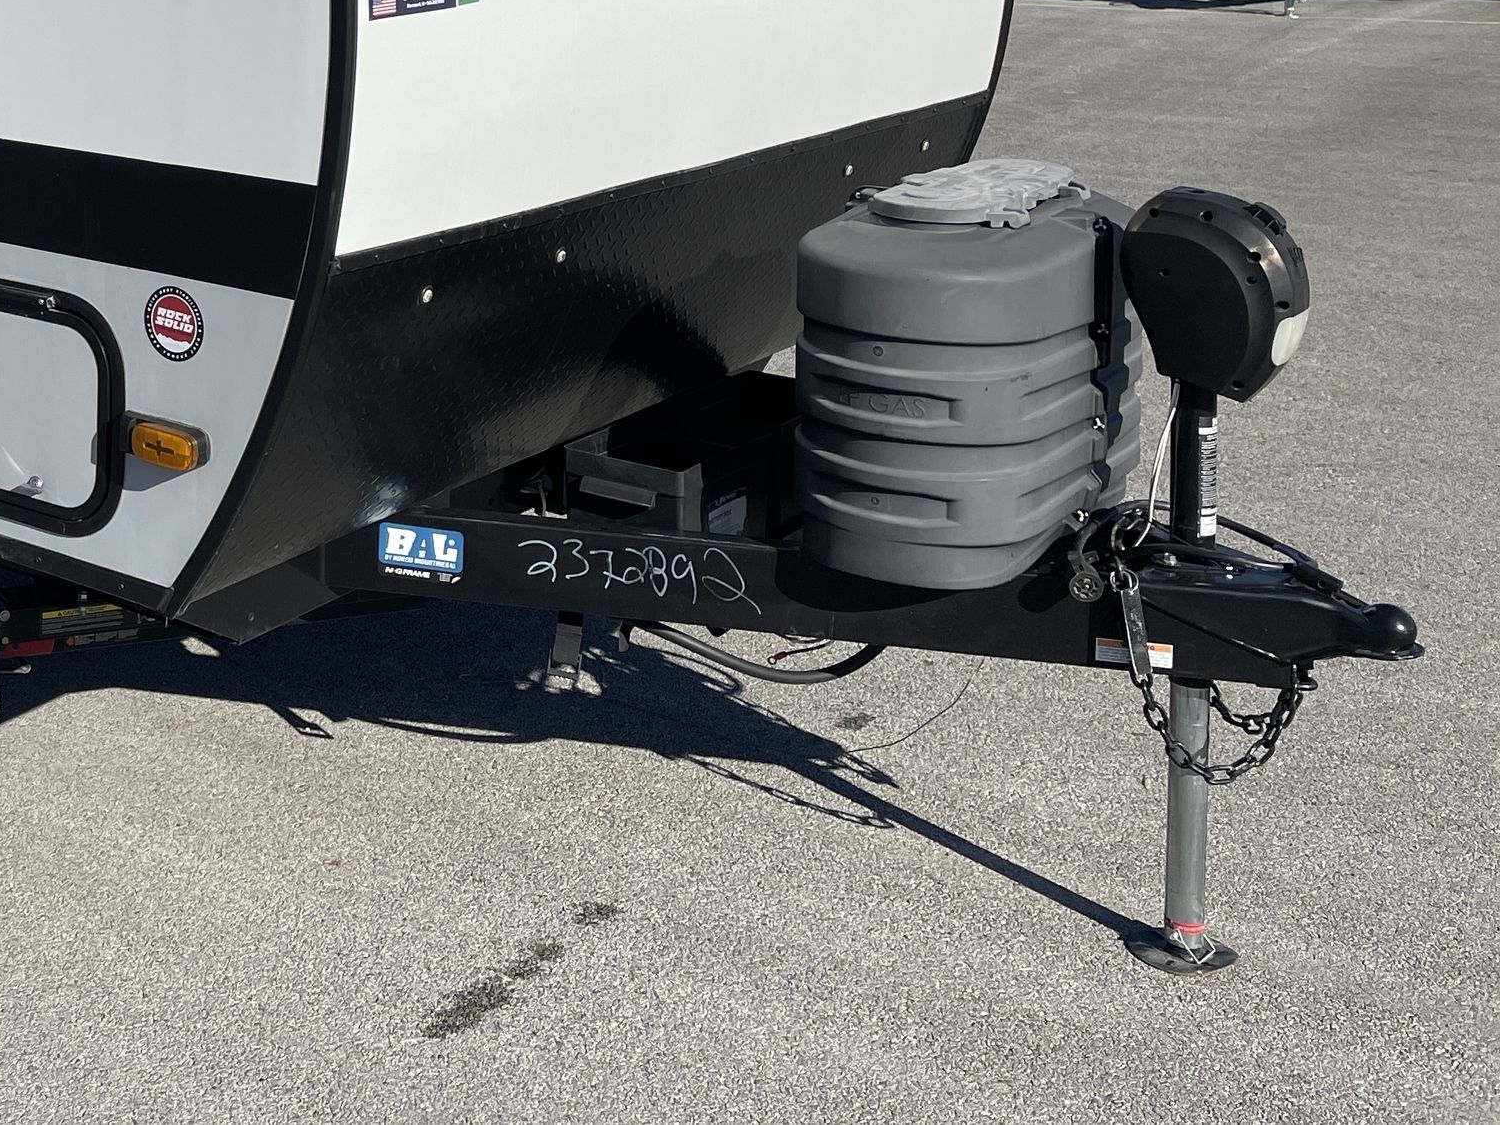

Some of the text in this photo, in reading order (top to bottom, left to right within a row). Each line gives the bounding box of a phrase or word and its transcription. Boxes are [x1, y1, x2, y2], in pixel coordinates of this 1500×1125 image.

[154, 315, 194, 334] SOLID
[156, 306, 193, 324] ROCK
[868, 393, 925, 419] GAS
